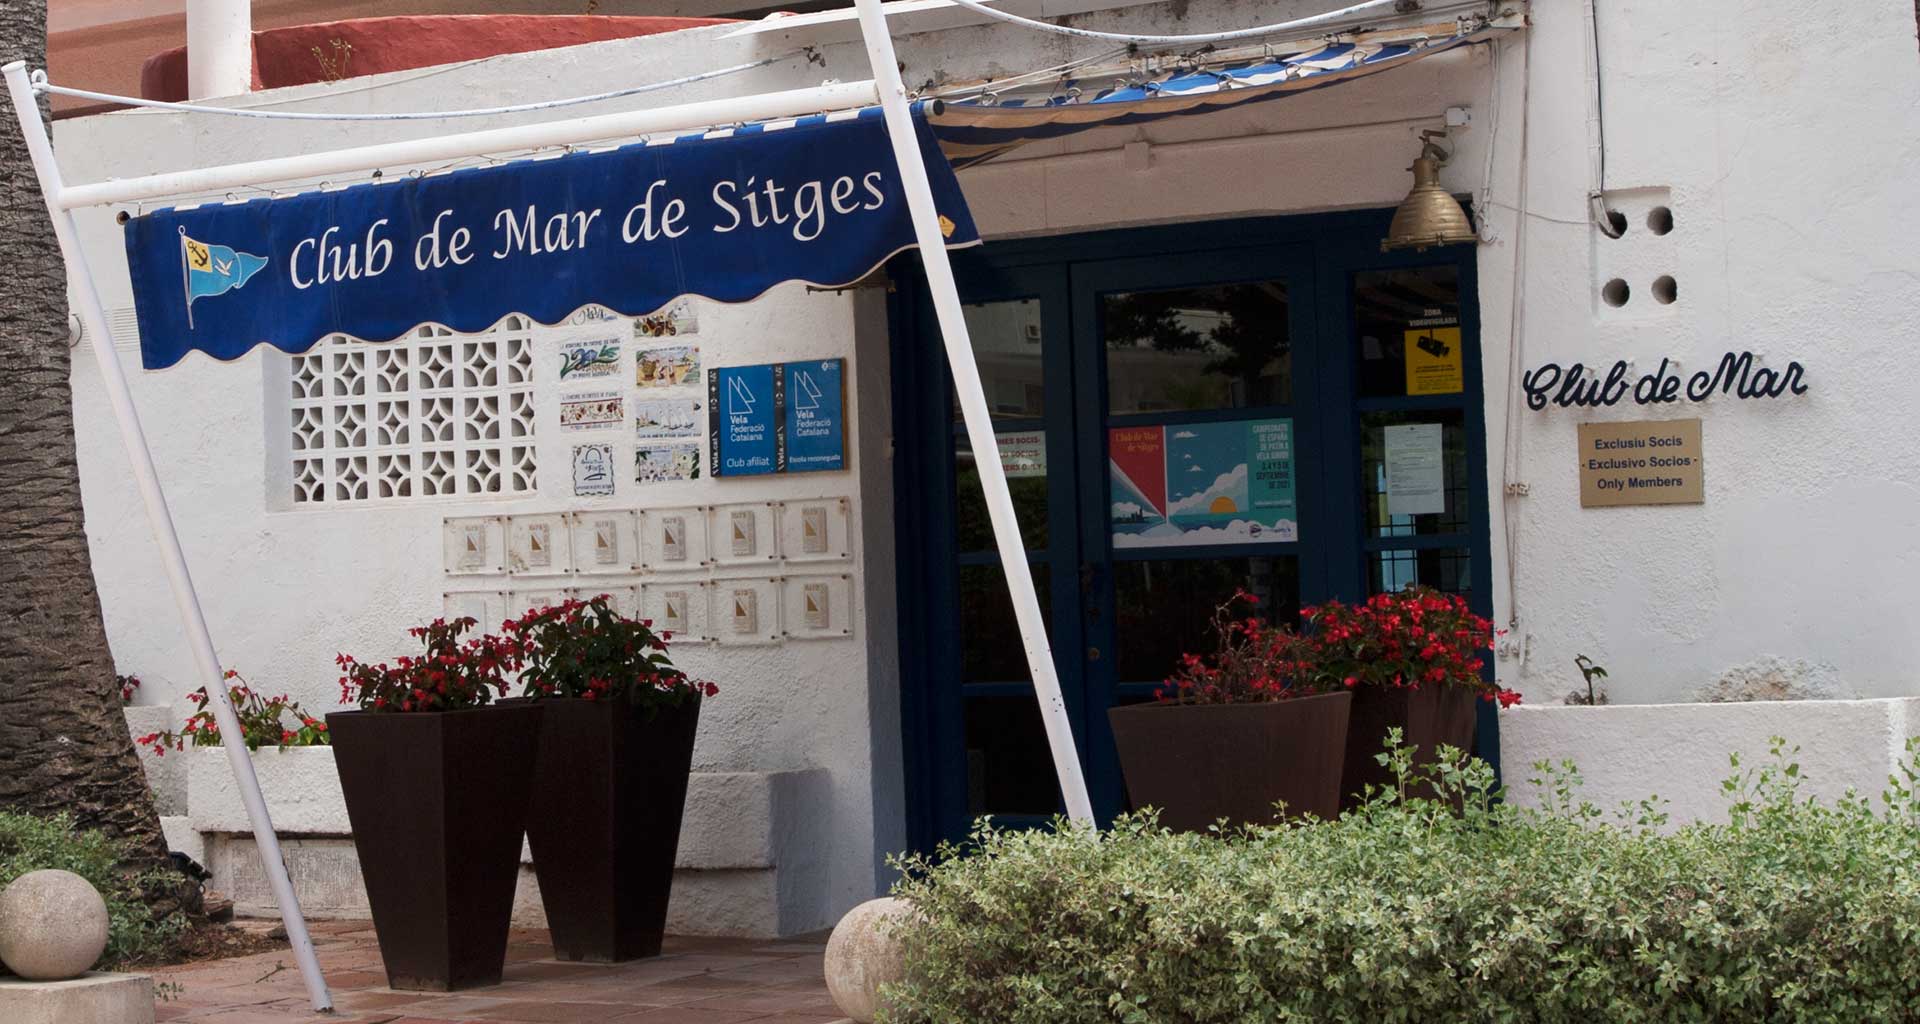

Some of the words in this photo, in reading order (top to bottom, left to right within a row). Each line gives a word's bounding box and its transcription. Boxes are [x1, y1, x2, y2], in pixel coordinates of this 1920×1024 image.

[291, 219, 394, 290] Club
[416, 210, 474, 272] de
[492, 204, 603, 261] Mar
[622, 180, 690, 244] de
[712, 171, 885, 241] Sitges
[1523, 360, 1631, 411] Club
[1634, 357, 1681, 405] de
[1686, 350, 1808, 403] Mar
[730, 415, 749, 424] Vela
[796, 410, 814, 419] Vela
[730, 423, 765, 433] Federació
[796, 419, 832, 428] Federació
[730, 433, 763, 442] Catalana
[796, 428, 830, 437] Catalana
[1595, 438, 1646, 449] Exclusiu
[1648, 436, 1682, 448] Socis
[726, 457, 746, 468] Club
[747, 456, 770, 467] afiliat
[1588, 457, 1646, 470] Exclusivo
[1650, 456, 1691, 468] Socios
[1597, 478, 1625, 491] Only
[1628, 476, 1682, 489] Members
